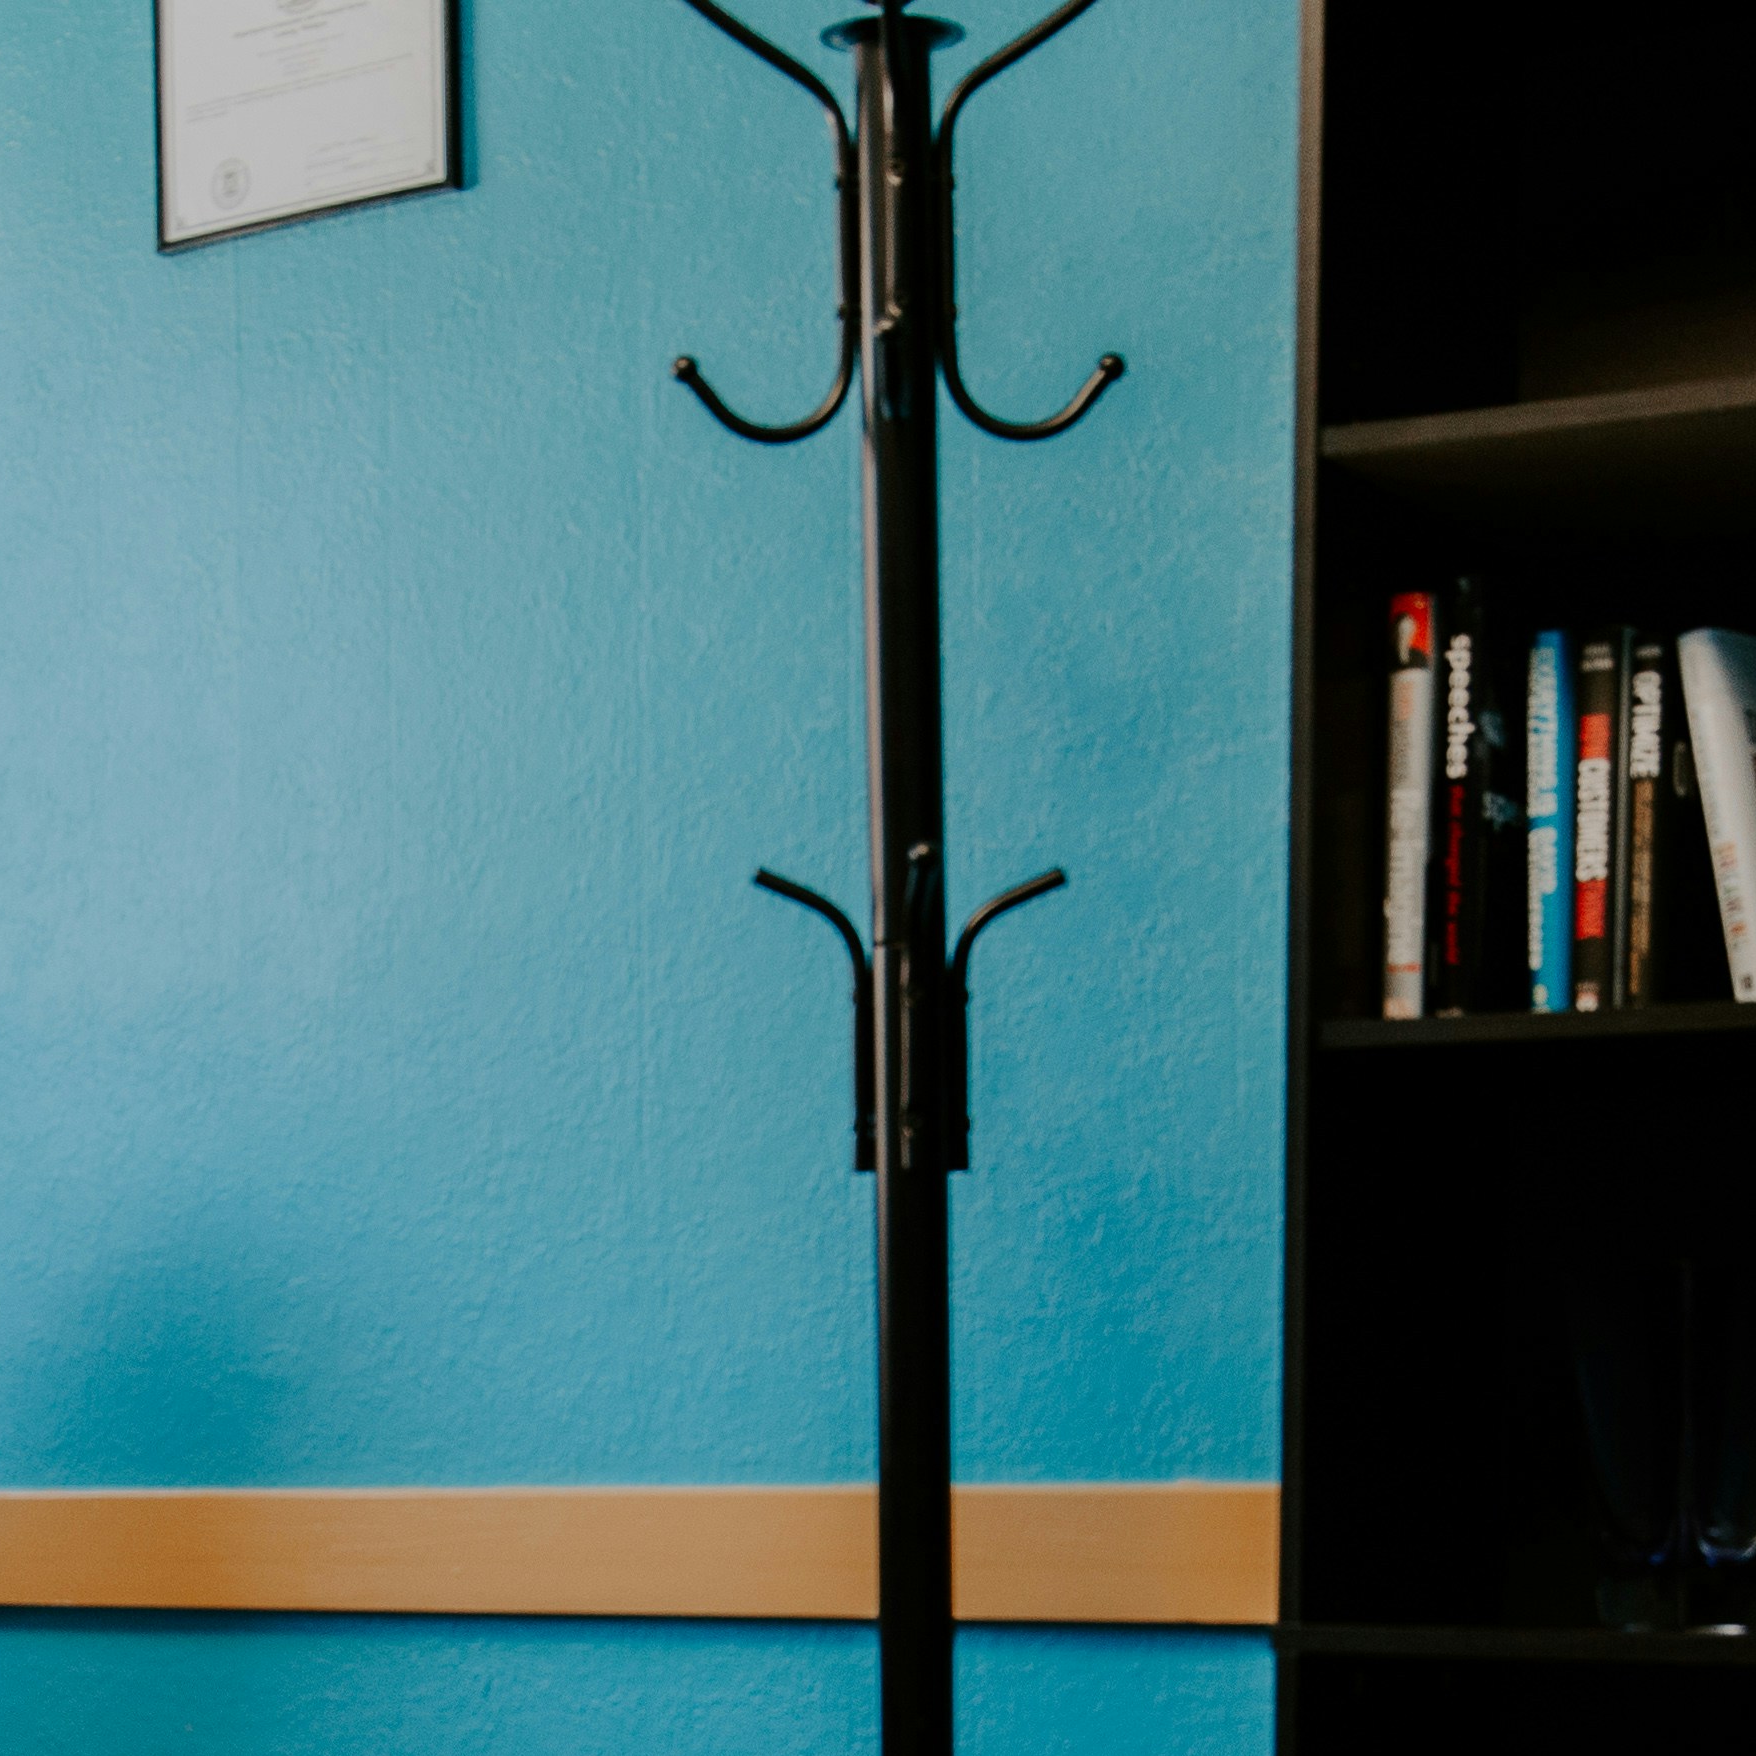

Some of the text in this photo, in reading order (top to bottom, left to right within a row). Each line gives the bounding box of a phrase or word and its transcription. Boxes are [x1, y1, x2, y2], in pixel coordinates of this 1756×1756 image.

[1443, 633, 1475, 779] speeches
[1629, 670, 1659, 778] OPTIMIZE
[1575, 758, 1609, 881] CUSTOMERS
